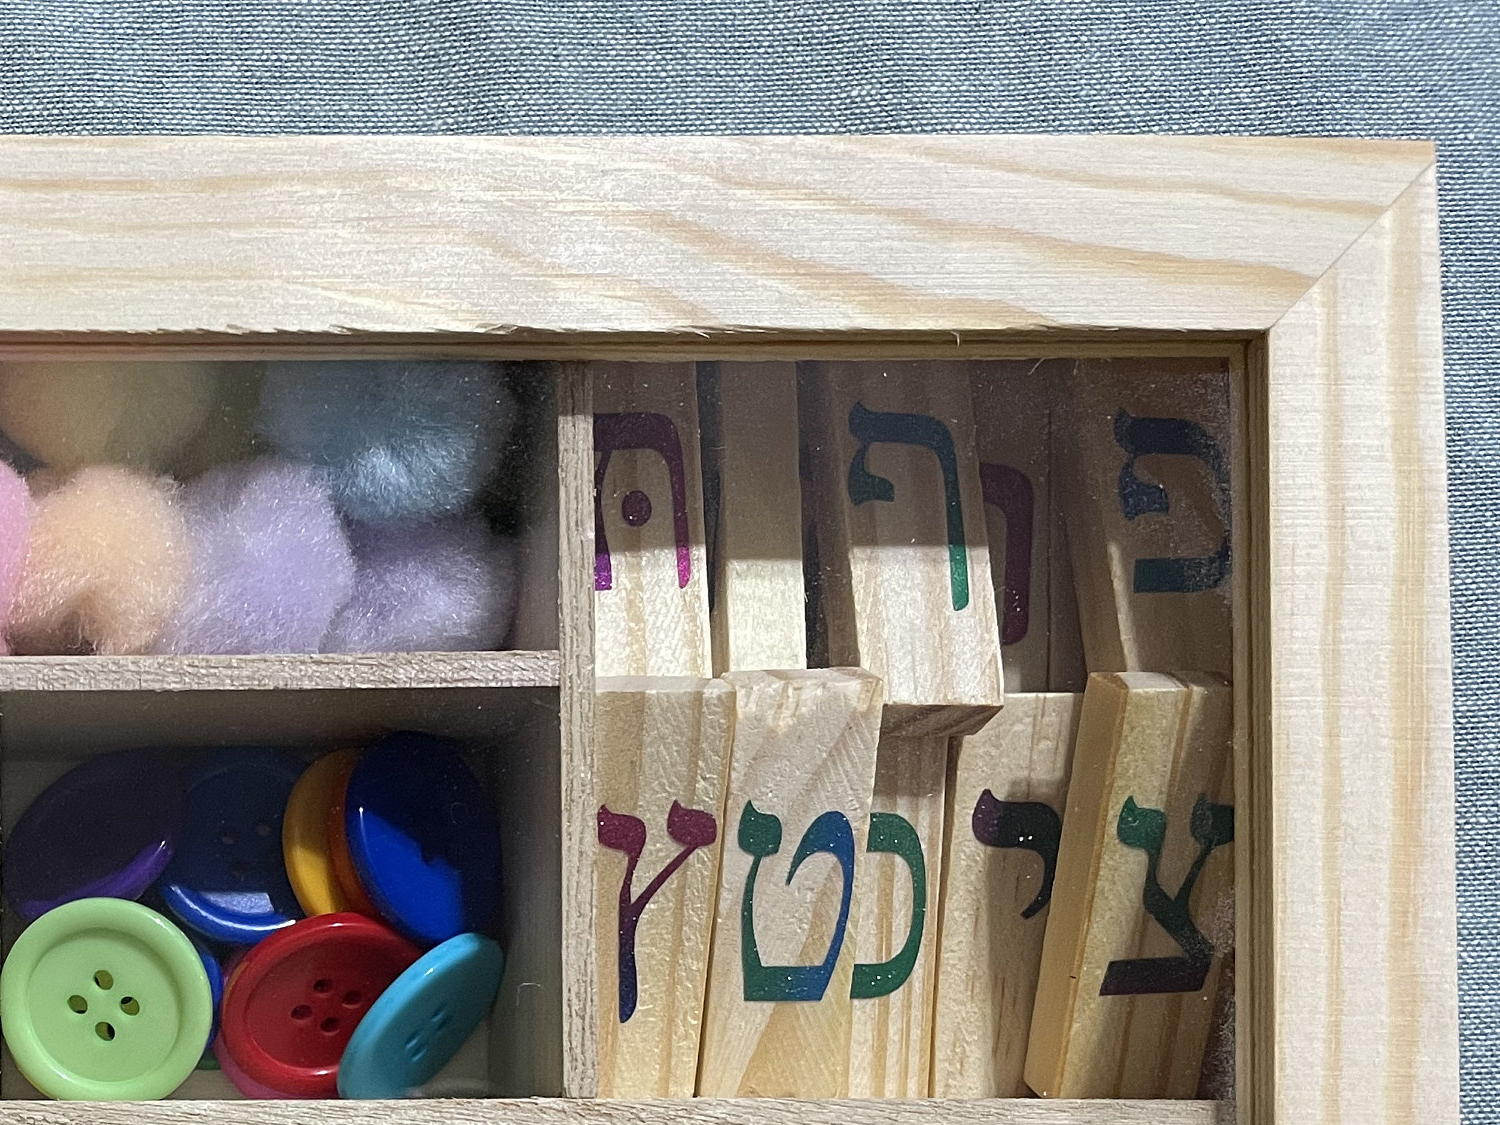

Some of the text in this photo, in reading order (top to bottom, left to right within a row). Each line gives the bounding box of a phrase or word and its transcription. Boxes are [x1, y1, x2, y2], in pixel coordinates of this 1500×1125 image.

[848, 402, 968, 611] ף
[1114, 408, 1231, 592] פ
[598, 804, 717, 1023] ץ
[738, 800, 854, 1001] ט
[1099, 793, 1234, 995] צ
